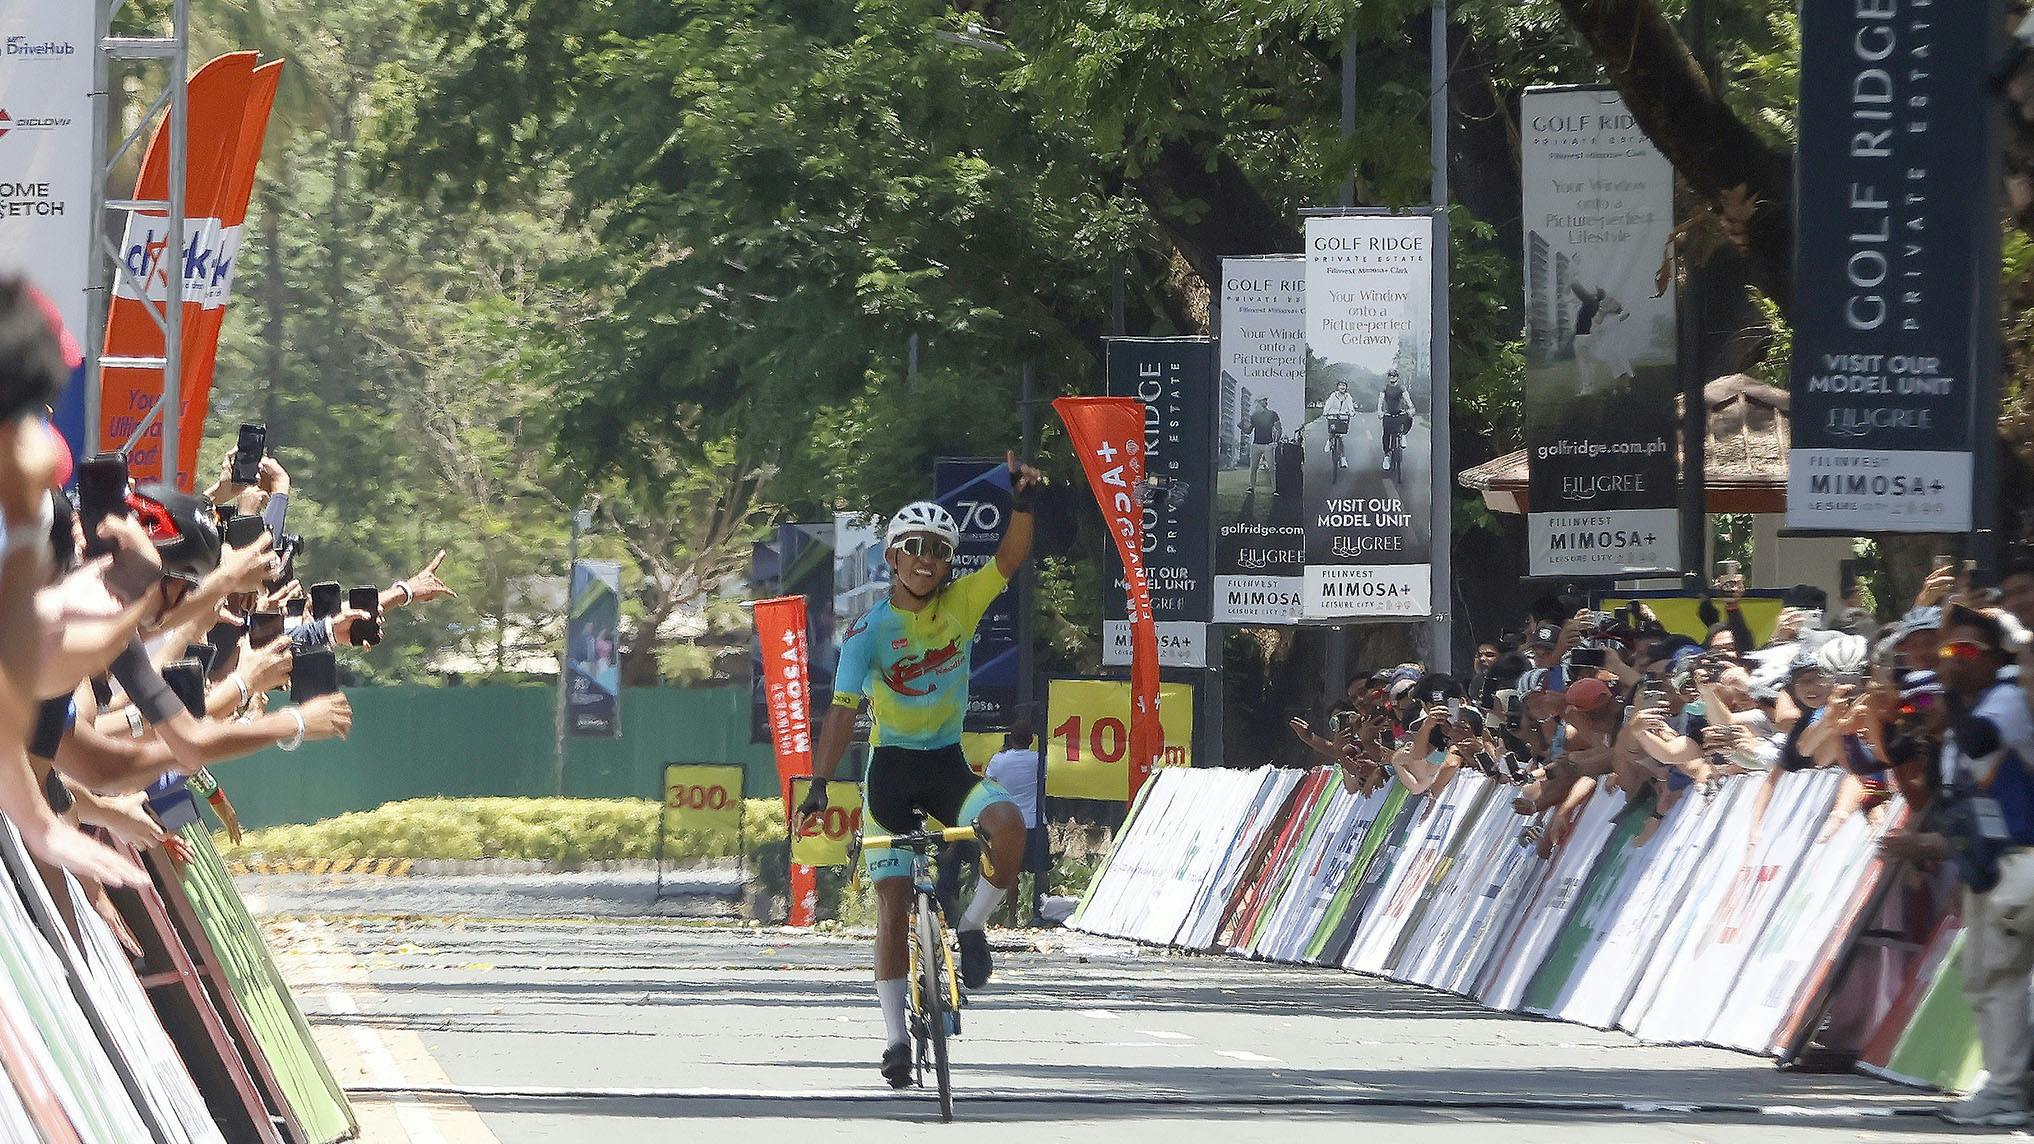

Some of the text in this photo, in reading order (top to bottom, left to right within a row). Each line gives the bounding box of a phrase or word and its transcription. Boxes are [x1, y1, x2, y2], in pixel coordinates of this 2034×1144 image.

[7, 42, 74, 55] DriveHub
[1532, 114, 1638, 132] GOLF RID
[1847, 0, 1897, 330] GOLF RIDGE
[0, 183, 49, 198] OME
[1314, 236, 1423, 251] GOLF RIDGE
[1314, 255, 1367, 263] PRIVATE
[1227, 278, 1306, 292] GOLF RID
[1329, 289, 1408, 303] Your Window
[1348, 305, 1388, 317] onto a
[1322, 318, 1412, 333] Picture-perfect
[1240, 327, 1266, 339] Your
[1341, 333, 1394, 346] Getaway
[1259, 342, 1286, 352] onto
[1824, 353, 1941, 375] VISIT OUR
[1808, 374, 1954, 396] MODEL UNIT
[1168, 362, 1181, 443] ESTATE
[1537, 436, 1667, 460] golfridge.com.ph
[1810, 474, 1946, 497] MIMOSA+
[1327, 498, 1402, 512] VISIT OUR
[957, 501, 1000, 532] 70
[1317, 514, 1412, 528] MODEL UNIT
[1549, 516, 1613, 528] FILINVEST
[1221, 522, 1304, 537] golfridge.com
[1550, 531, 1657, 550] MIMOSA+
[1159, 567, 1189, 579] OUR
[1322, 570, 1375, 578] FILINVEST
[1165, 579, 1196, 591] UNIT
[1227, 580, 1279, 588] FILINVEST
[1322, 583, 1411, 597] MIMOSA+
[1228, 591, 1301, 605] MIMOSA
